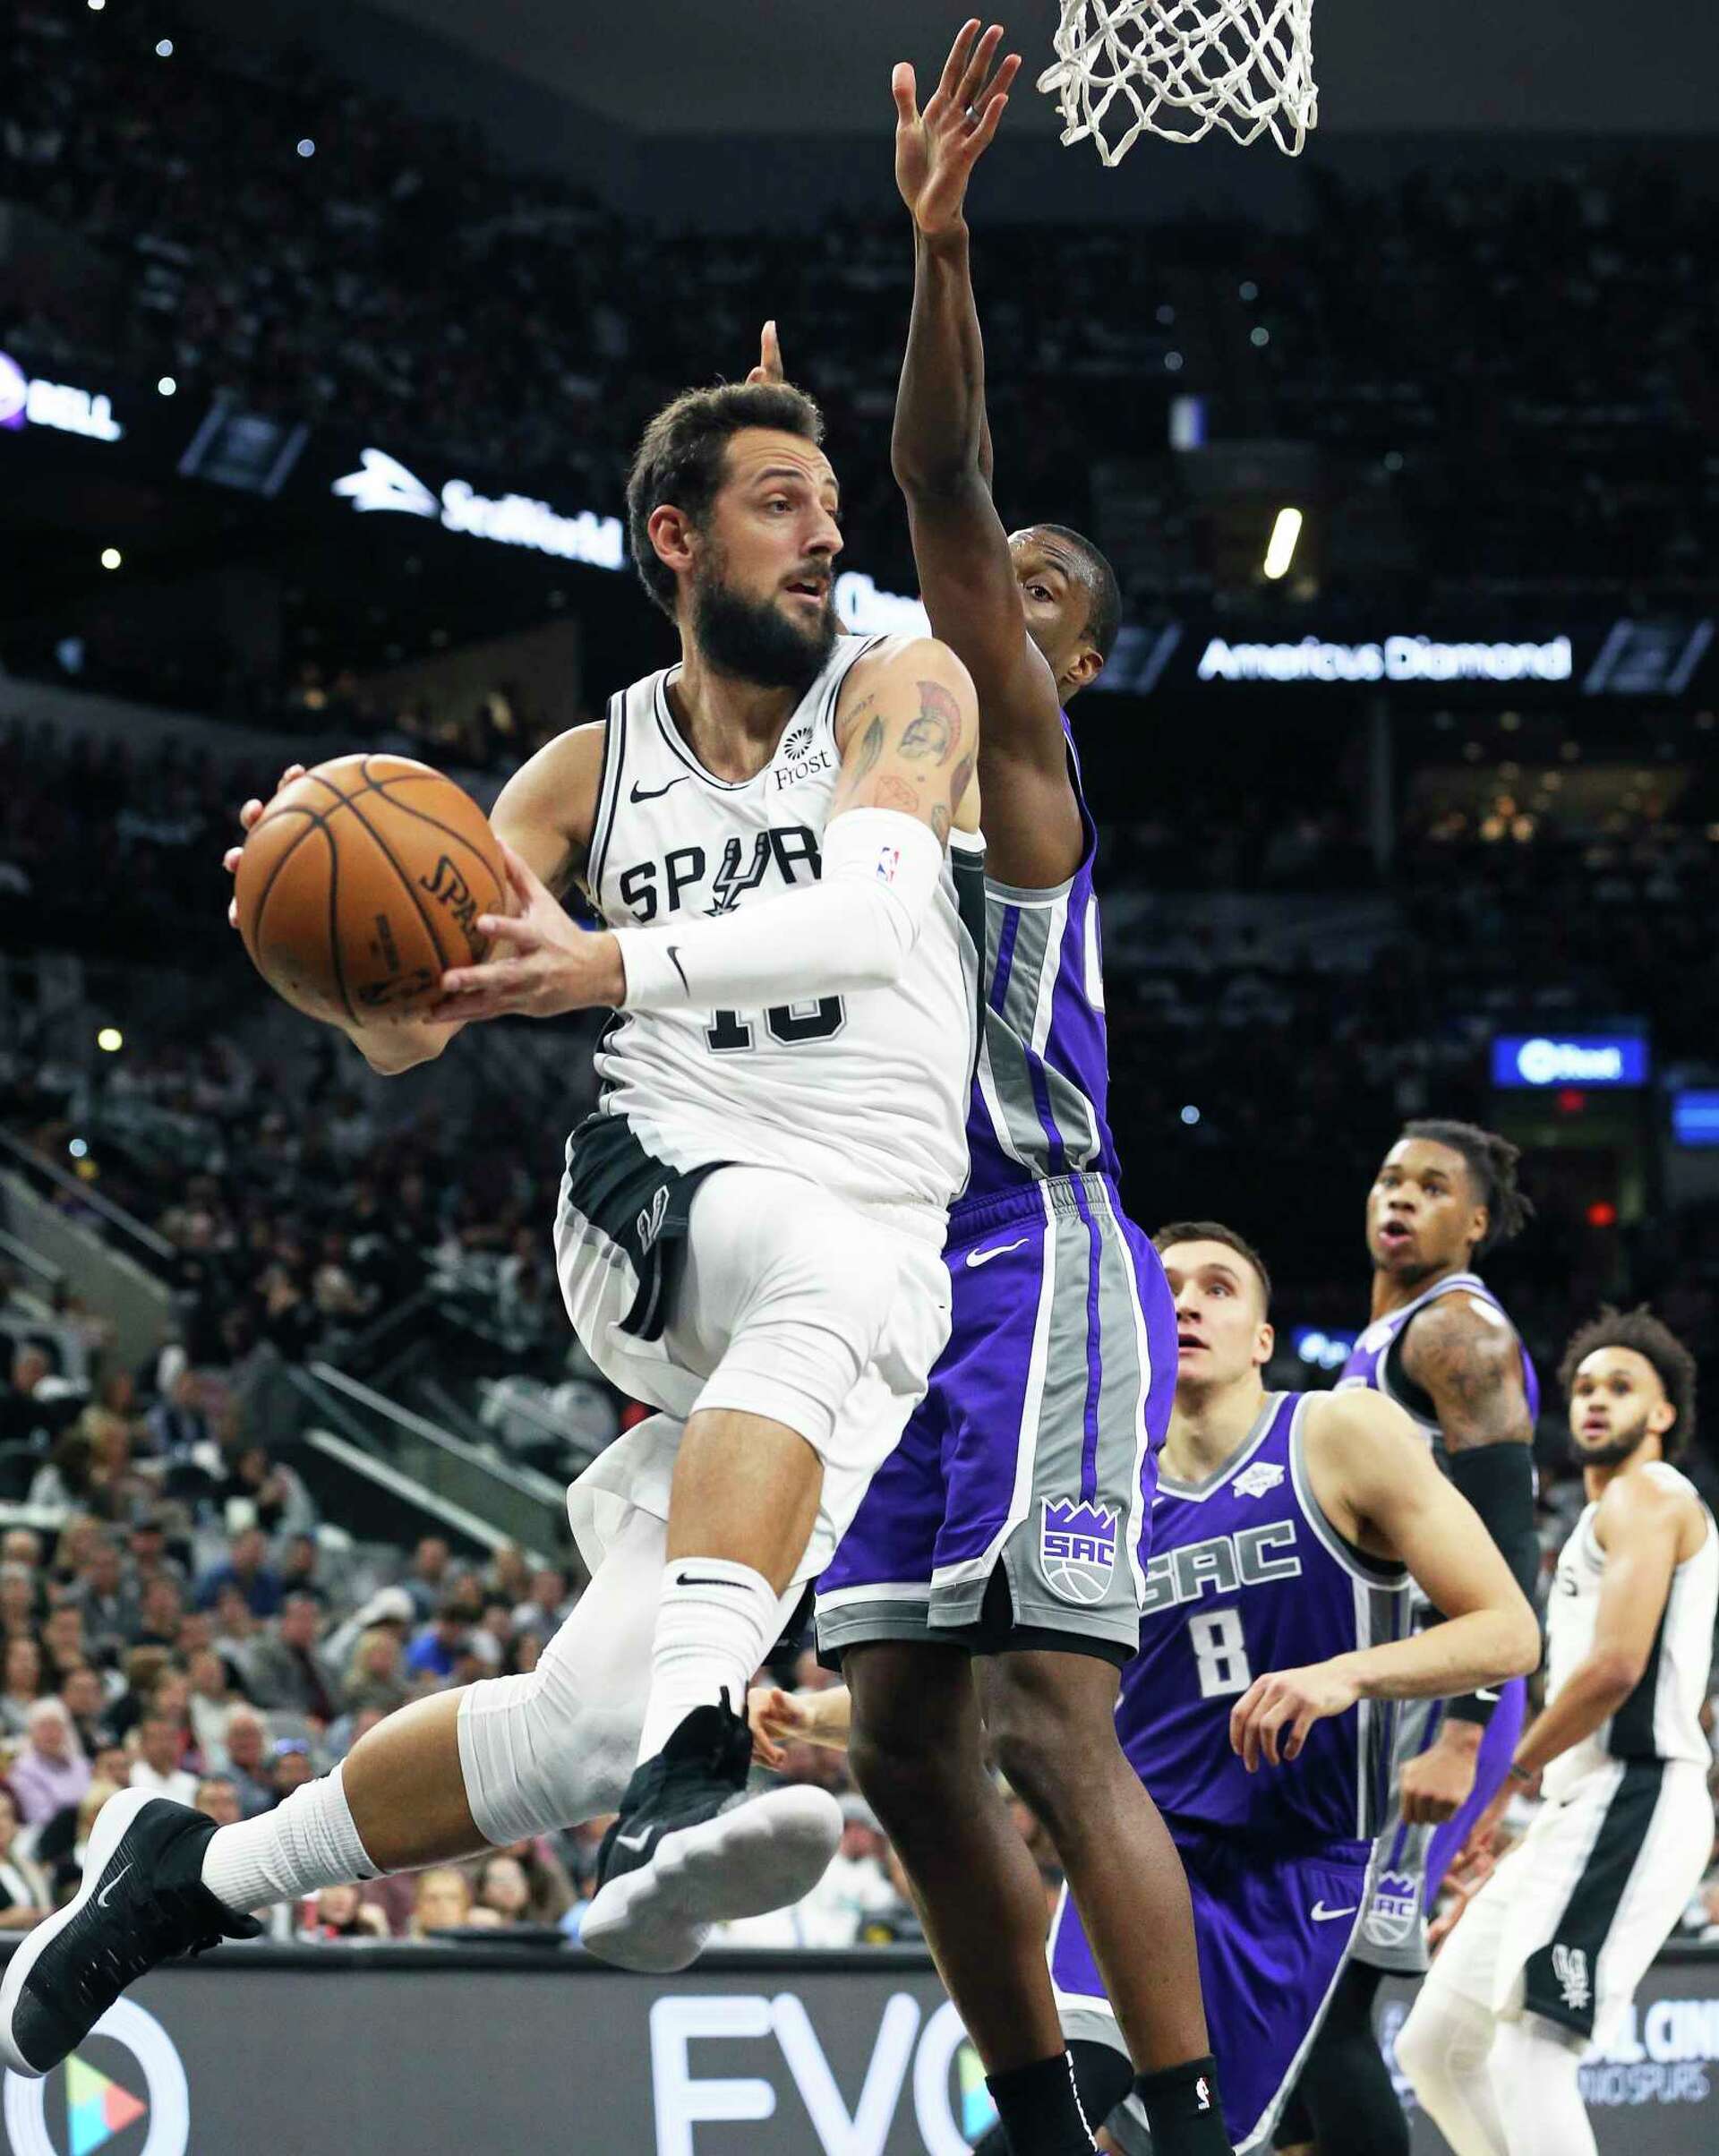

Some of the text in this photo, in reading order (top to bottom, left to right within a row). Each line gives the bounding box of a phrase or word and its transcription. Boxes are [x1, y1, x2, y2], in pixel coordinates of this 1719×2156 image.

[774, 749, 832, 791] Frost
[620, 826, 822, 923] SPUR
[1043, 1534, 1115, 1567] SAC
[1189, 1608, 1253, 1698] 8
